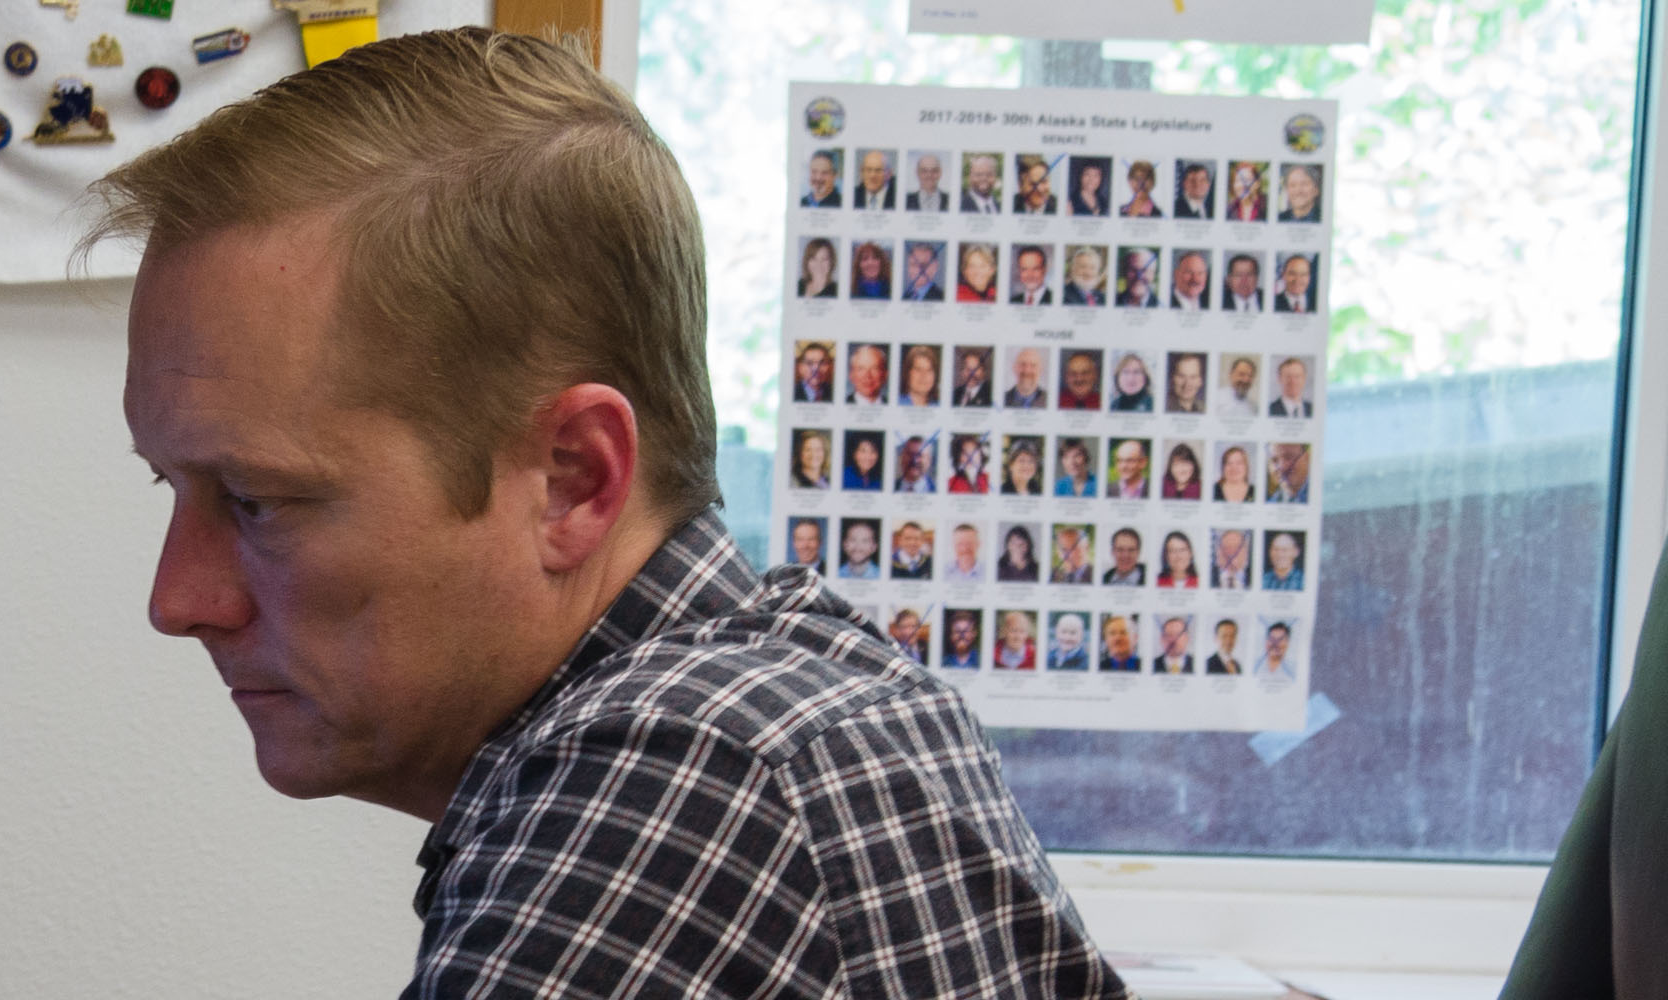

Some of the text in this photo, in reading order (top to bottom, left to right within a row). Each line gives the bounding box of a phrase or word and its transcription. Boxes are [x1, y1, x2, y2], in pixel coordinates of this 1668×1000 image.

[1002, 112, 1032, 127] 30th
[1037, 113, 1086, 128] Alaska
[1091, 115, 1127, 129] State
[1132, 116, 1212, 133] Legislature
[1041, 133, 1087, 145] SENATE
